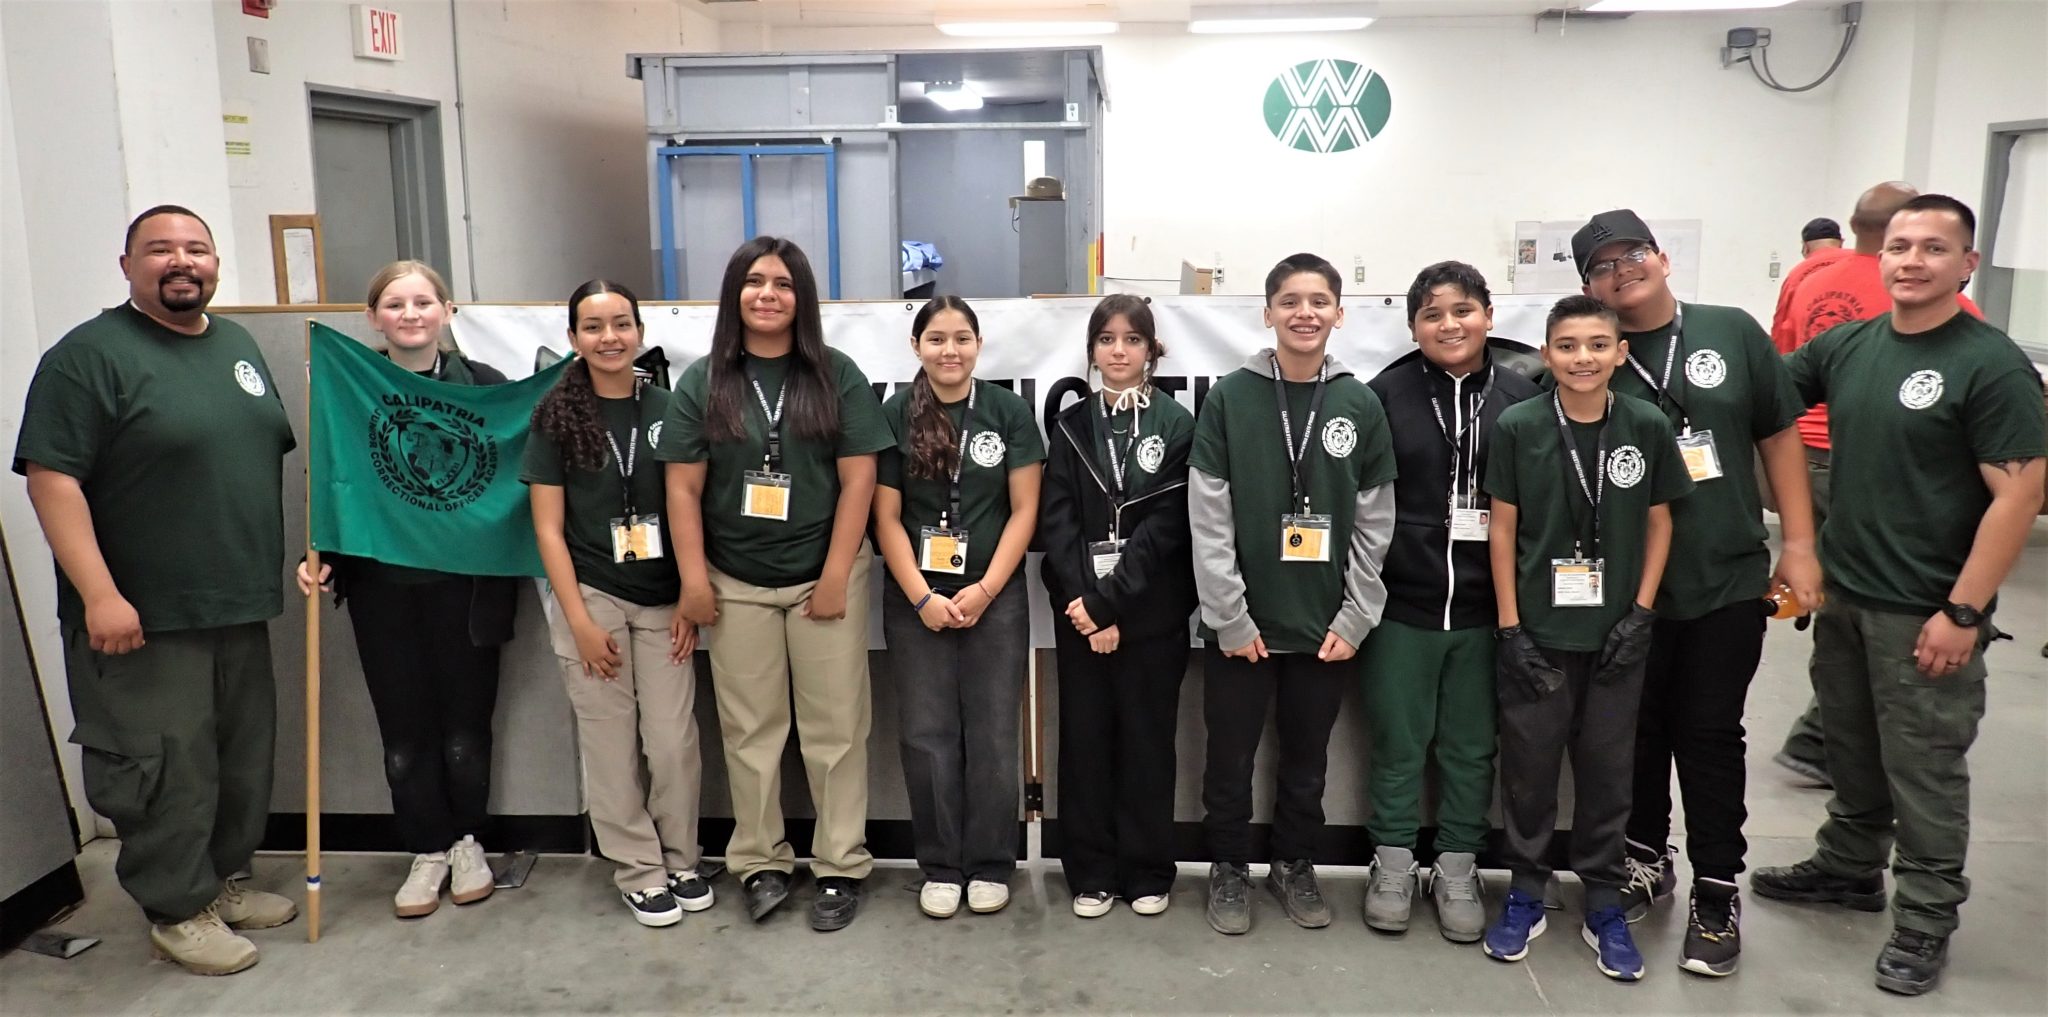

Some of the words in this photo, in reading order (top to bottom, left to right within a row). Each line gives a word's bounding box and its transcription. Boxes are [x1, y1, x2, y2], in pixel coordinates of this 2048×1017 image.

[370, 10, 397, 55] EXIT
[1807, 290, 1864, 314] CALIPATRIA
[368, 408, 382, 449] JUNIOR
[382, 394, 485, 428] CALIPATRIA
[483, 434, 498, 485] ACADEMY
[1610, 445, 1643, 458] CALIPATRIA
[370, 451, 442, 512] CORRECTIONAL
[444, 485, 487, 512] OFFICER
